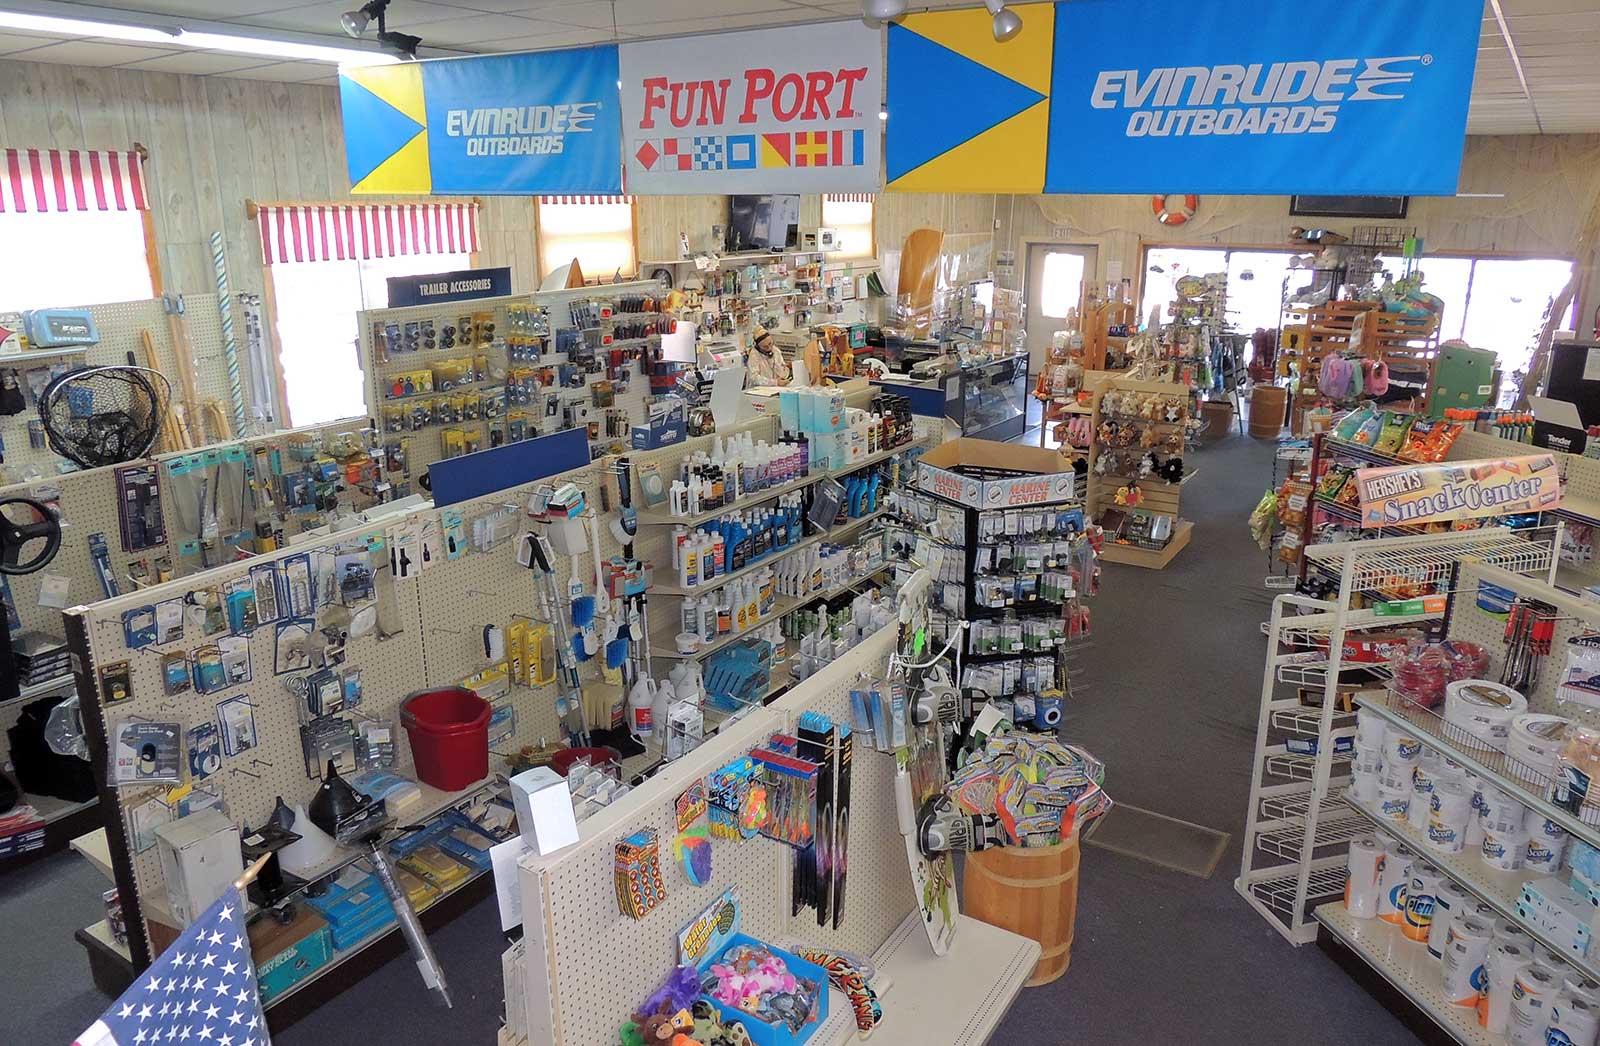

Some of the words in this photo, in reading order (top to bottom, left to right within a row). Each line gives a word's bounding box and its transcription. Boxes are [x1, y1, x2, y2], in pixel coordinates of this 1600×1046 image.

[1090, 58, 1359, 110] EVINRUDE
[639, 77, 731, 129] FUN
[738, 67, 868, 123] PORT
[445, 103, 570, 137] EVINRUDE
[1125, 104, 1340, 138] OUTBOARDS
[466, 134, 564, 156] OUTBOARDS
[420, 283, 448, 296] TRAILER
[450, 278, 491, 293] ACCESSORIES
[1547, 433, 1572, 446] Tender
[934, 473, 963, 491] MARINE
[1009, 480, 1051, 495] MARINE
[1366, 472, 1423, 500] HERSHEY'S
[934, 484, 962, 501] CENTER
[1008, 491, 1049, 505] CENTER
[1383, 481, 1464, 525] Snack
[1463, 476, 1542, 510] Center
[1415, 778, 1432, 788] Scott
[1431, 829, 1453, 838] Scott
[1483, 842, 1503, 852] Scott
[1527, 847, 1550, 858] Scott
[683, 916, 707, 951] Water
[687, 911, 722, 960] Grenades
